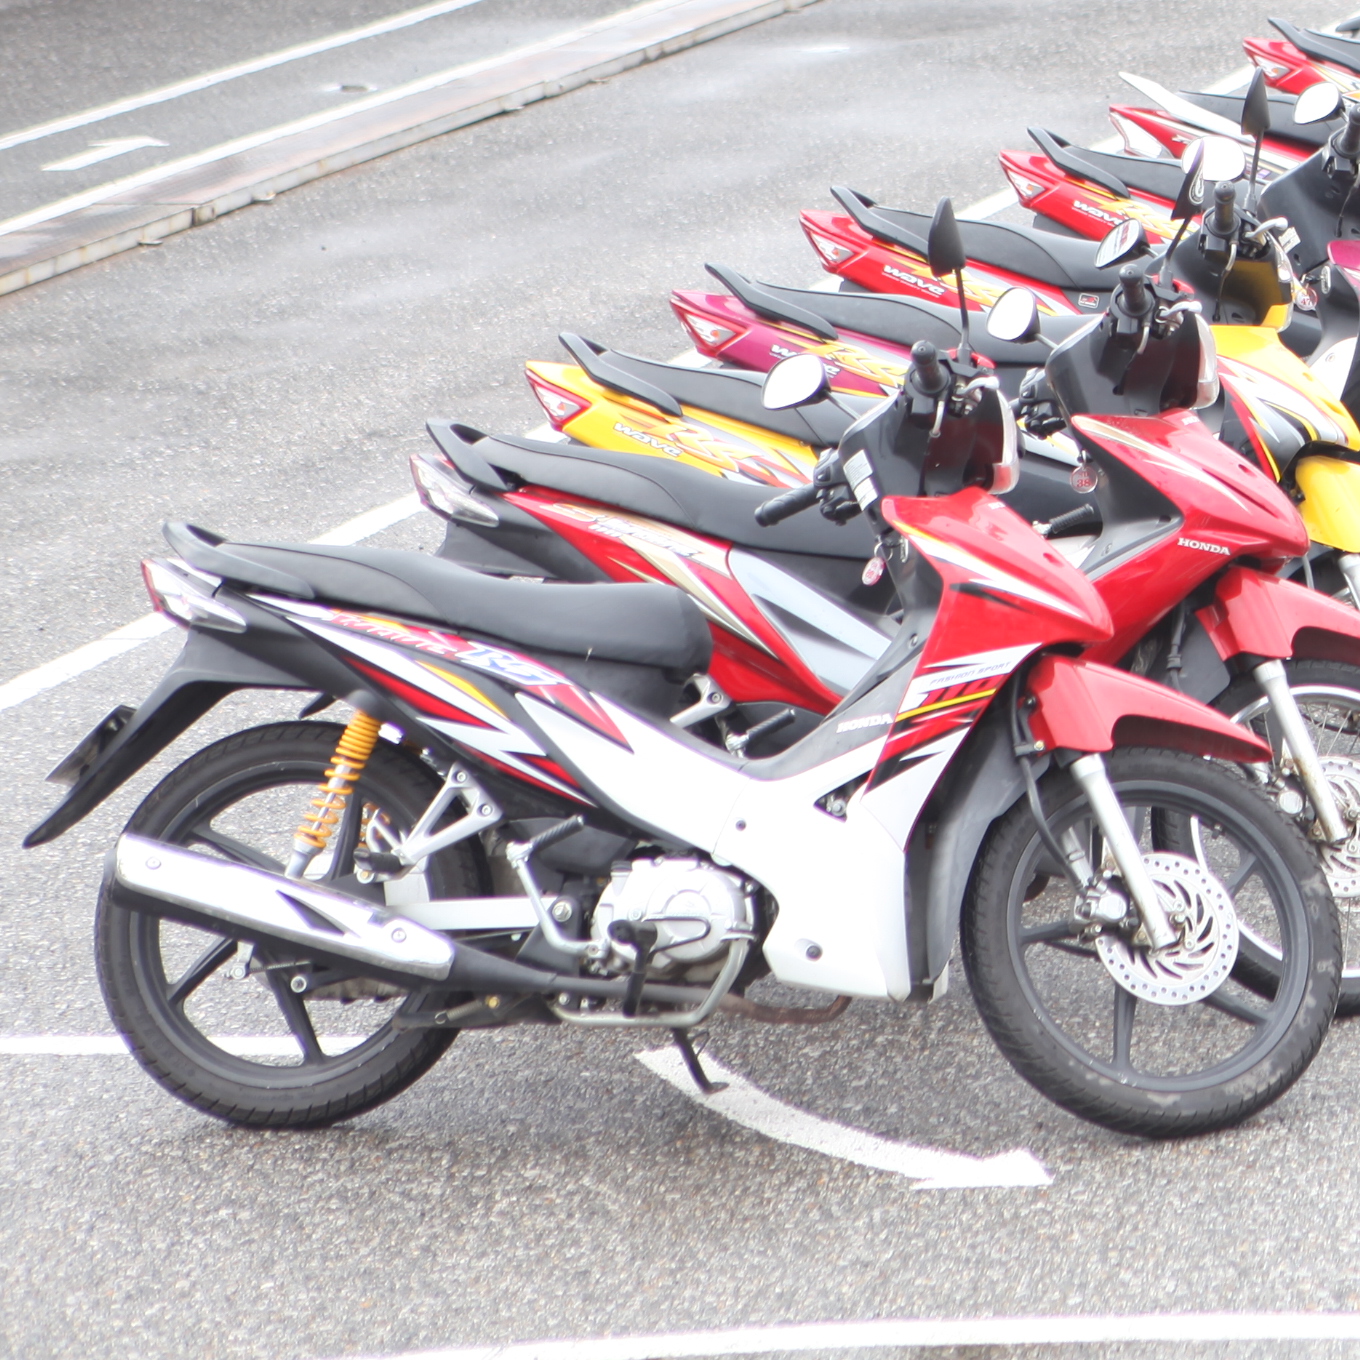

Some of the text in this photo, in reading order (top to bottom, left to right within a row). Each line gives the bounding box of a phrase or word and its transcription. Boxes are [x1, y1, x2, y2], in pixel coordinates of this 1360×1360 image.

[1076, 478, 1093, 489] 38
[1177, 537, 1231, 556] HONDA
[930, 661, 1012, 686] FASHION SPORT
[836, 712, 894, 734] HONDA
